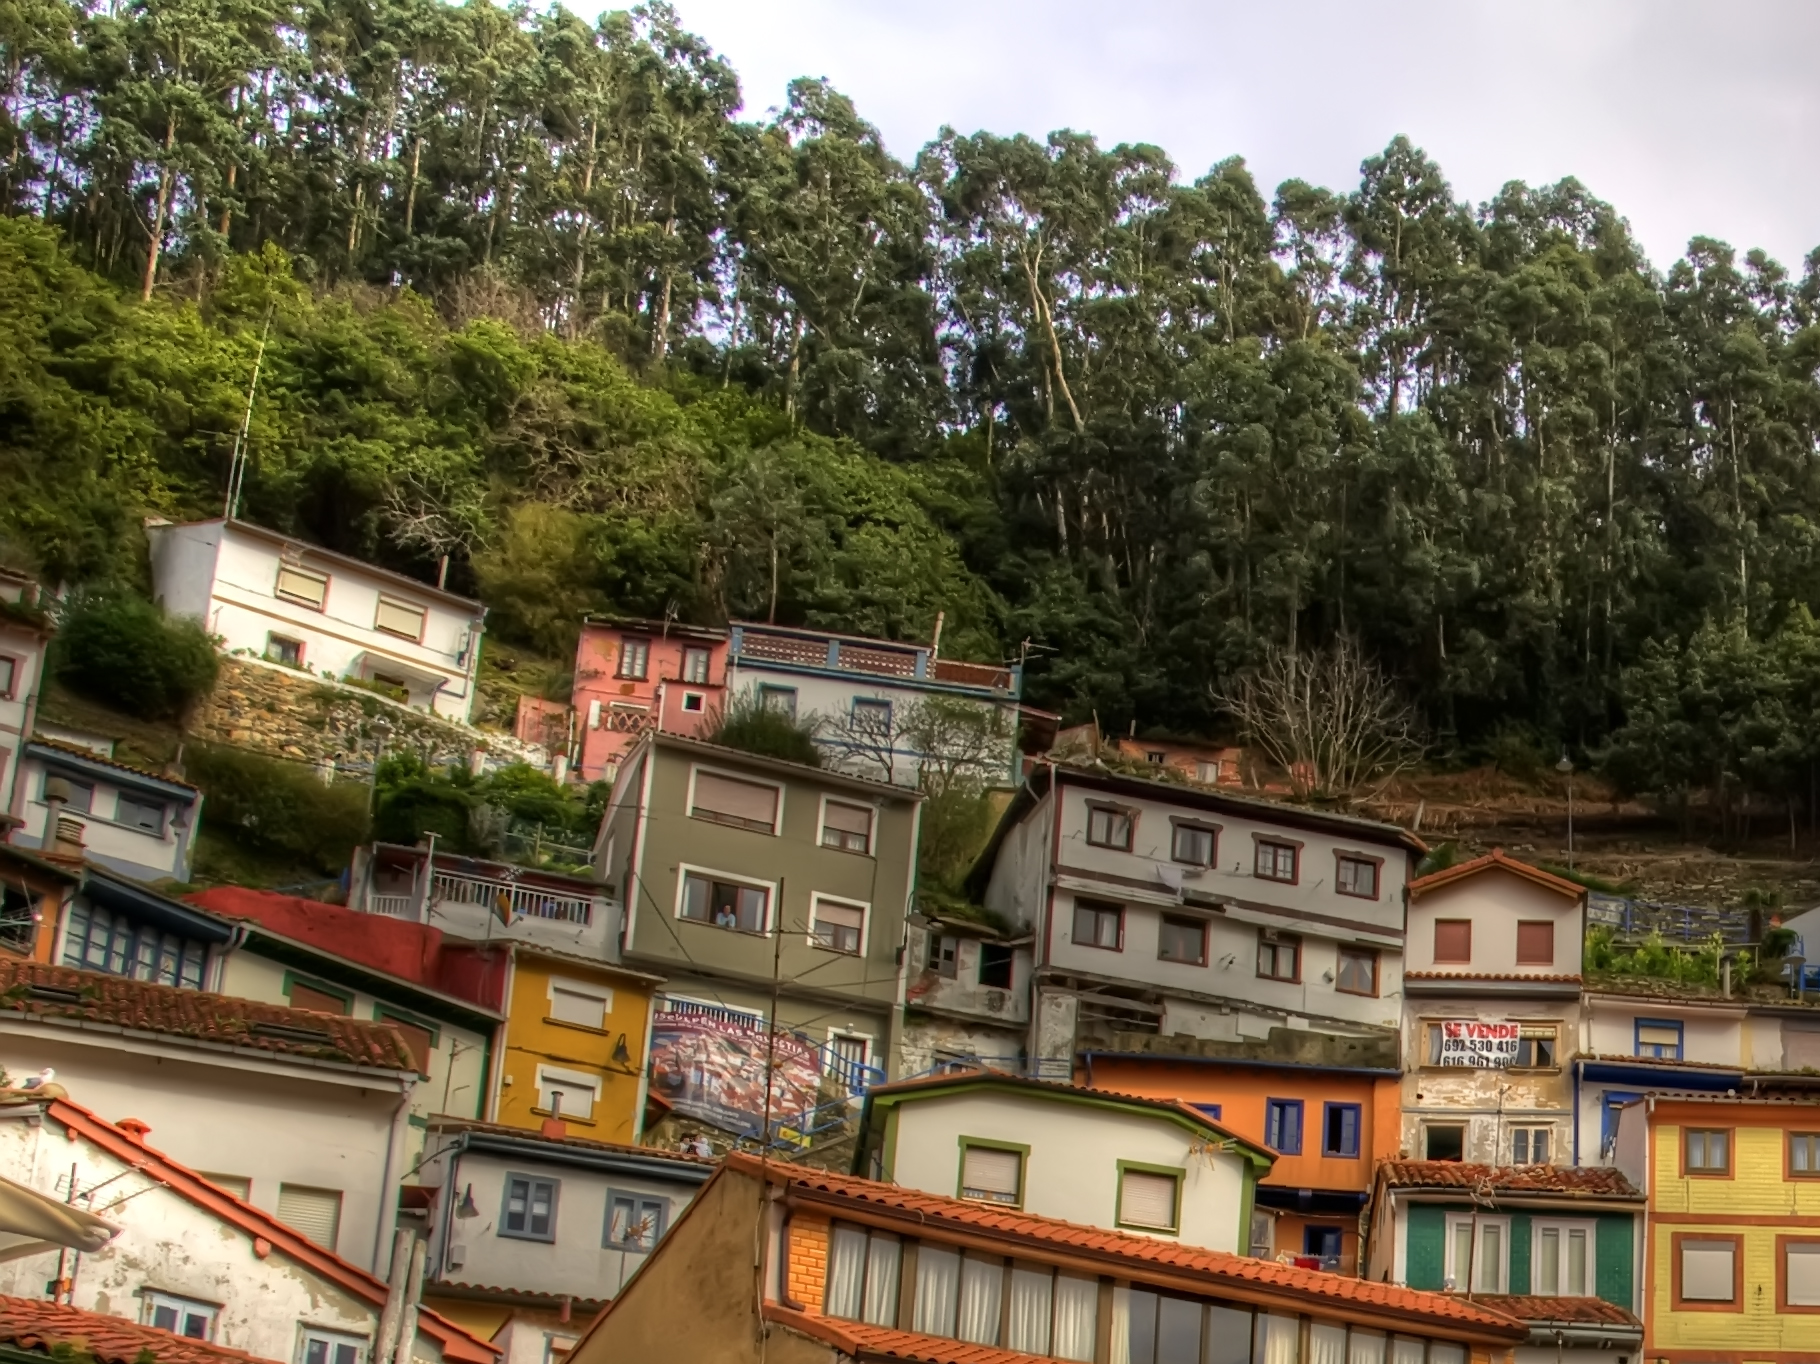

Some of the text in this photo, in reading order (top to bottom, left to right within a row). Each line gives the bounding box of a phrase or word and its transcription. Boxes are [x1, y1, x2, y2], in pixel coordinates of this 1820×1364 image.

[719, 1024, 743, 1037] LAS
[1444, 1022, 1518, 1039] SE VENDE
[1444, 1039, 1518, 1053] 692 530 416
